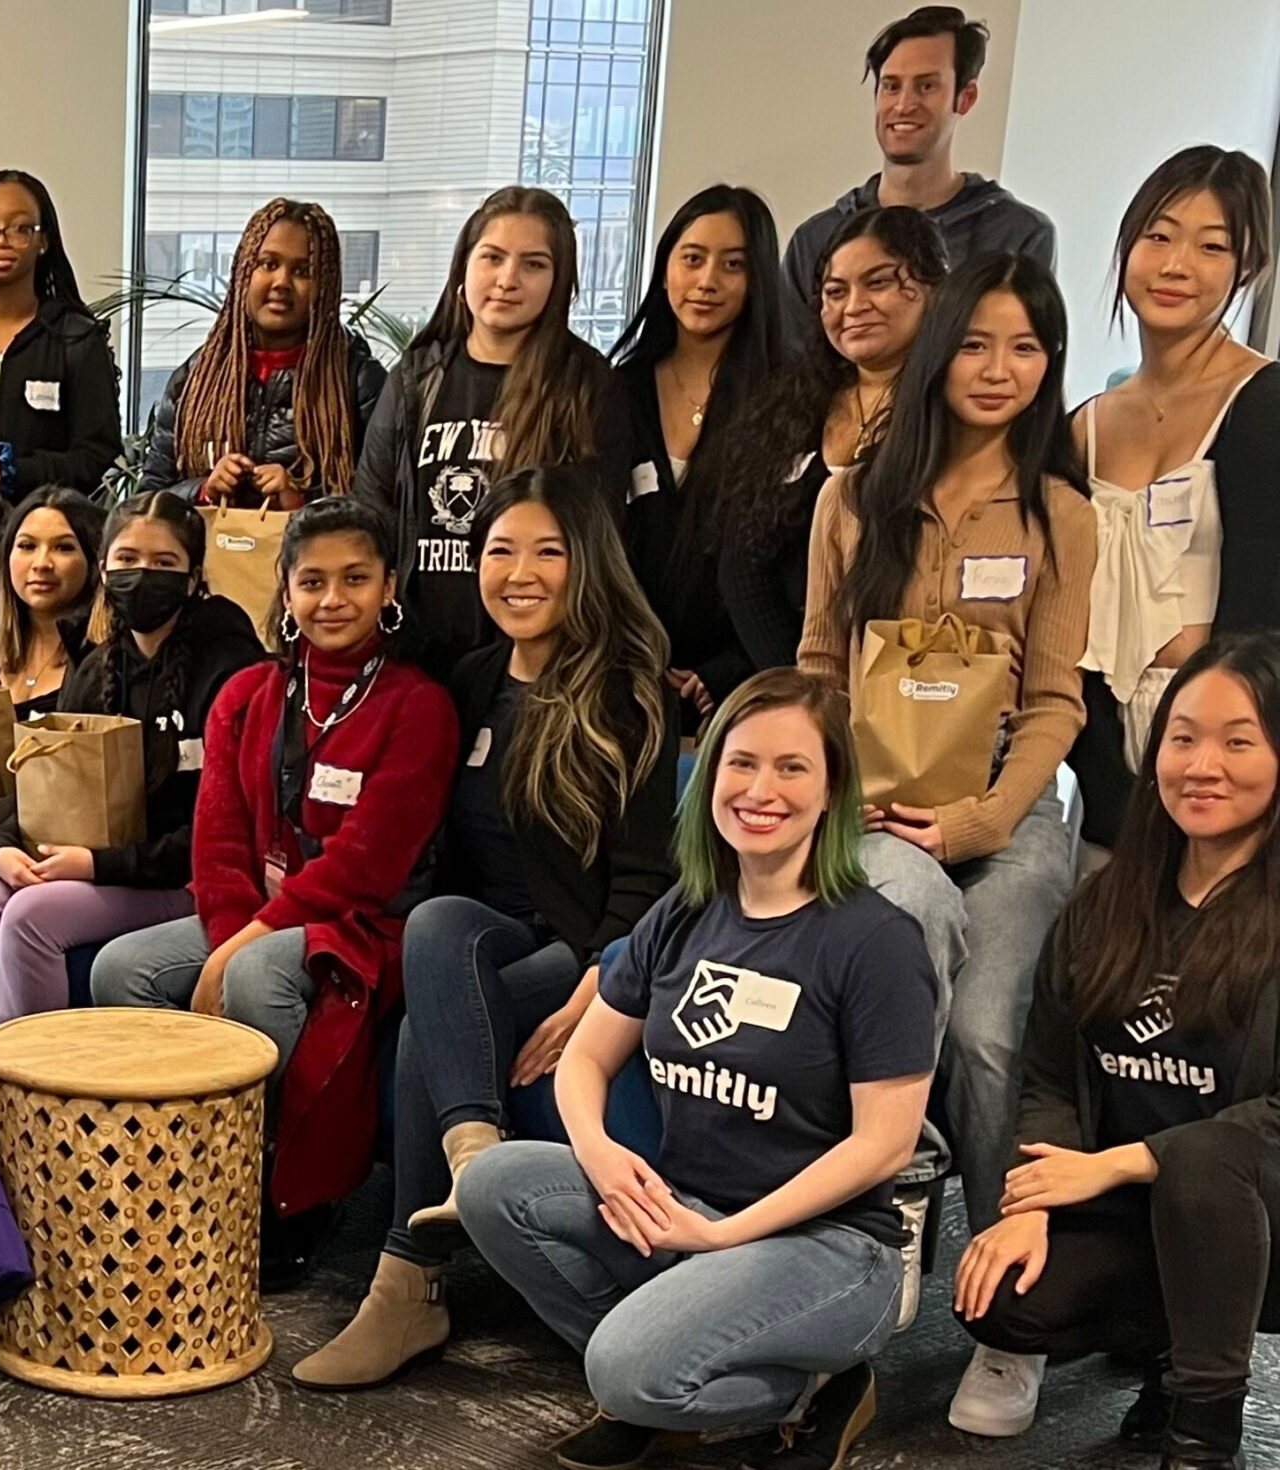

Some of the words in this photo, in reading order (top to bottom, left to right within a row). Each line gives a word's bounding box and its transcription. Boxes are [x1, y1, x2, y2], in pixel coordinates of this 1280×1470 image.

[417, 421, 467, 468] EW
[417, 538, 477, 573] TRIBE
[915, 683, 957, 696] Remitly
[646, 1052, 778, 1121] emitly
[1095, 1046, 1216, 1094] emitly
